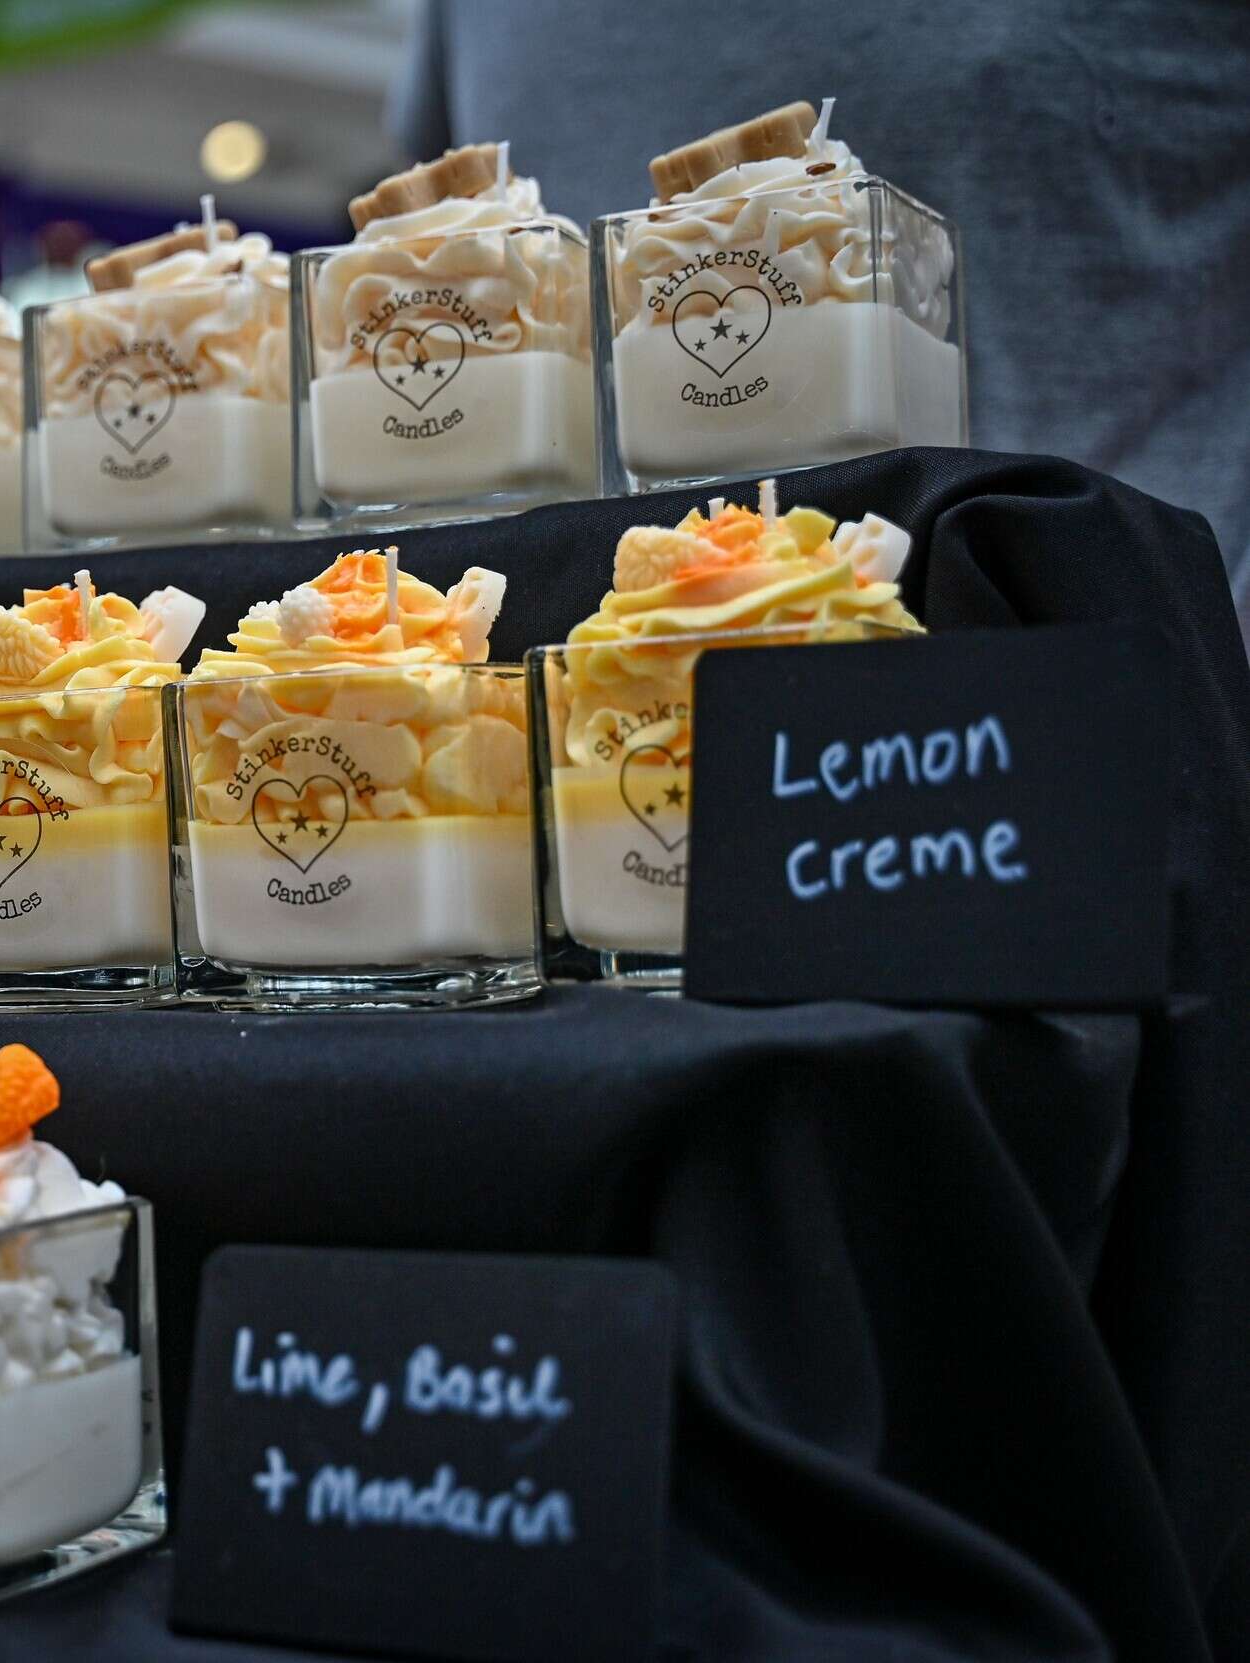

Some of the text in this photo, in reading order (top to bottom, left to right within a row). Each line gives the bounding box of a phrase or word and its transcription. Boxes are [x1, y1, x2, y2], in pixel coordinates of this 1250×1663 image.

[648, 250, 802, 313] StinkerStuff
[350, 288, 492, 349] StinkerStuff
[681, 376, 769, 407] Candles
[383, 408, 464, 439] Candles
[227, 736, 376, 801] StinkerStuff
[772, 716, 1011, 800] Lemon
[267, 874, 352, 905] Candles
[234, 1327, 571, 1433] Lime, Basil
[252, 1446, 575, 1545] + Mandarin
